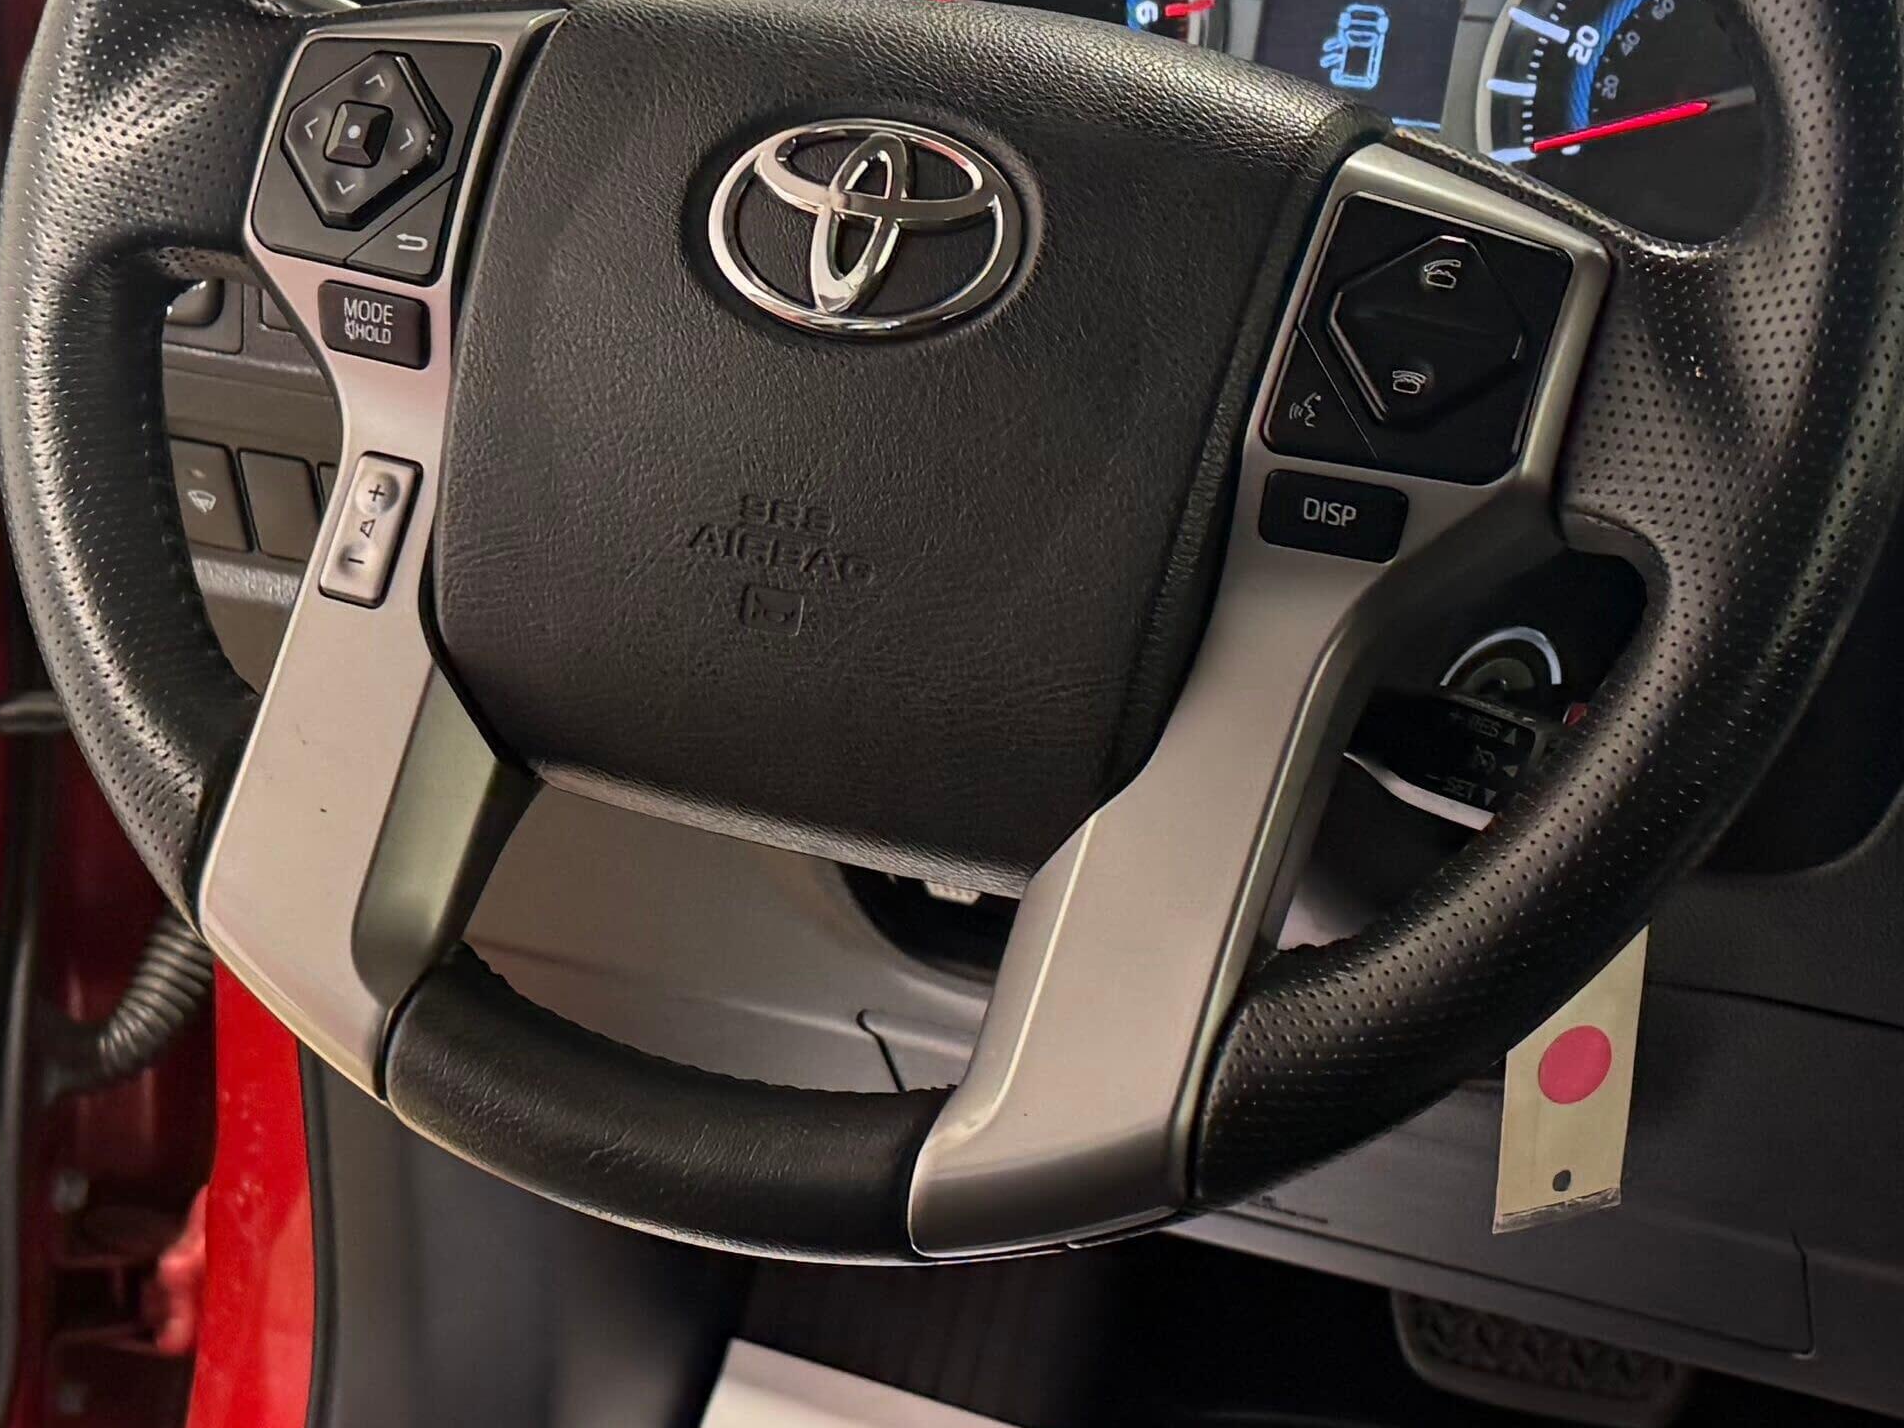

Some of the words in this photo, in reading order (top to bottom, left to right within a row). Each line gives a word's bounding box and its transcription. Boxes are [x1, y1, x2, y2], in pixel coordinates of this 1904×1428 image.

[1566, 24, 1601, 67] 20
[343, 296, 395, 327] MODE
[356, 318, 393, 346] HOLD
[1301, 494, 1358, 530] DISP
